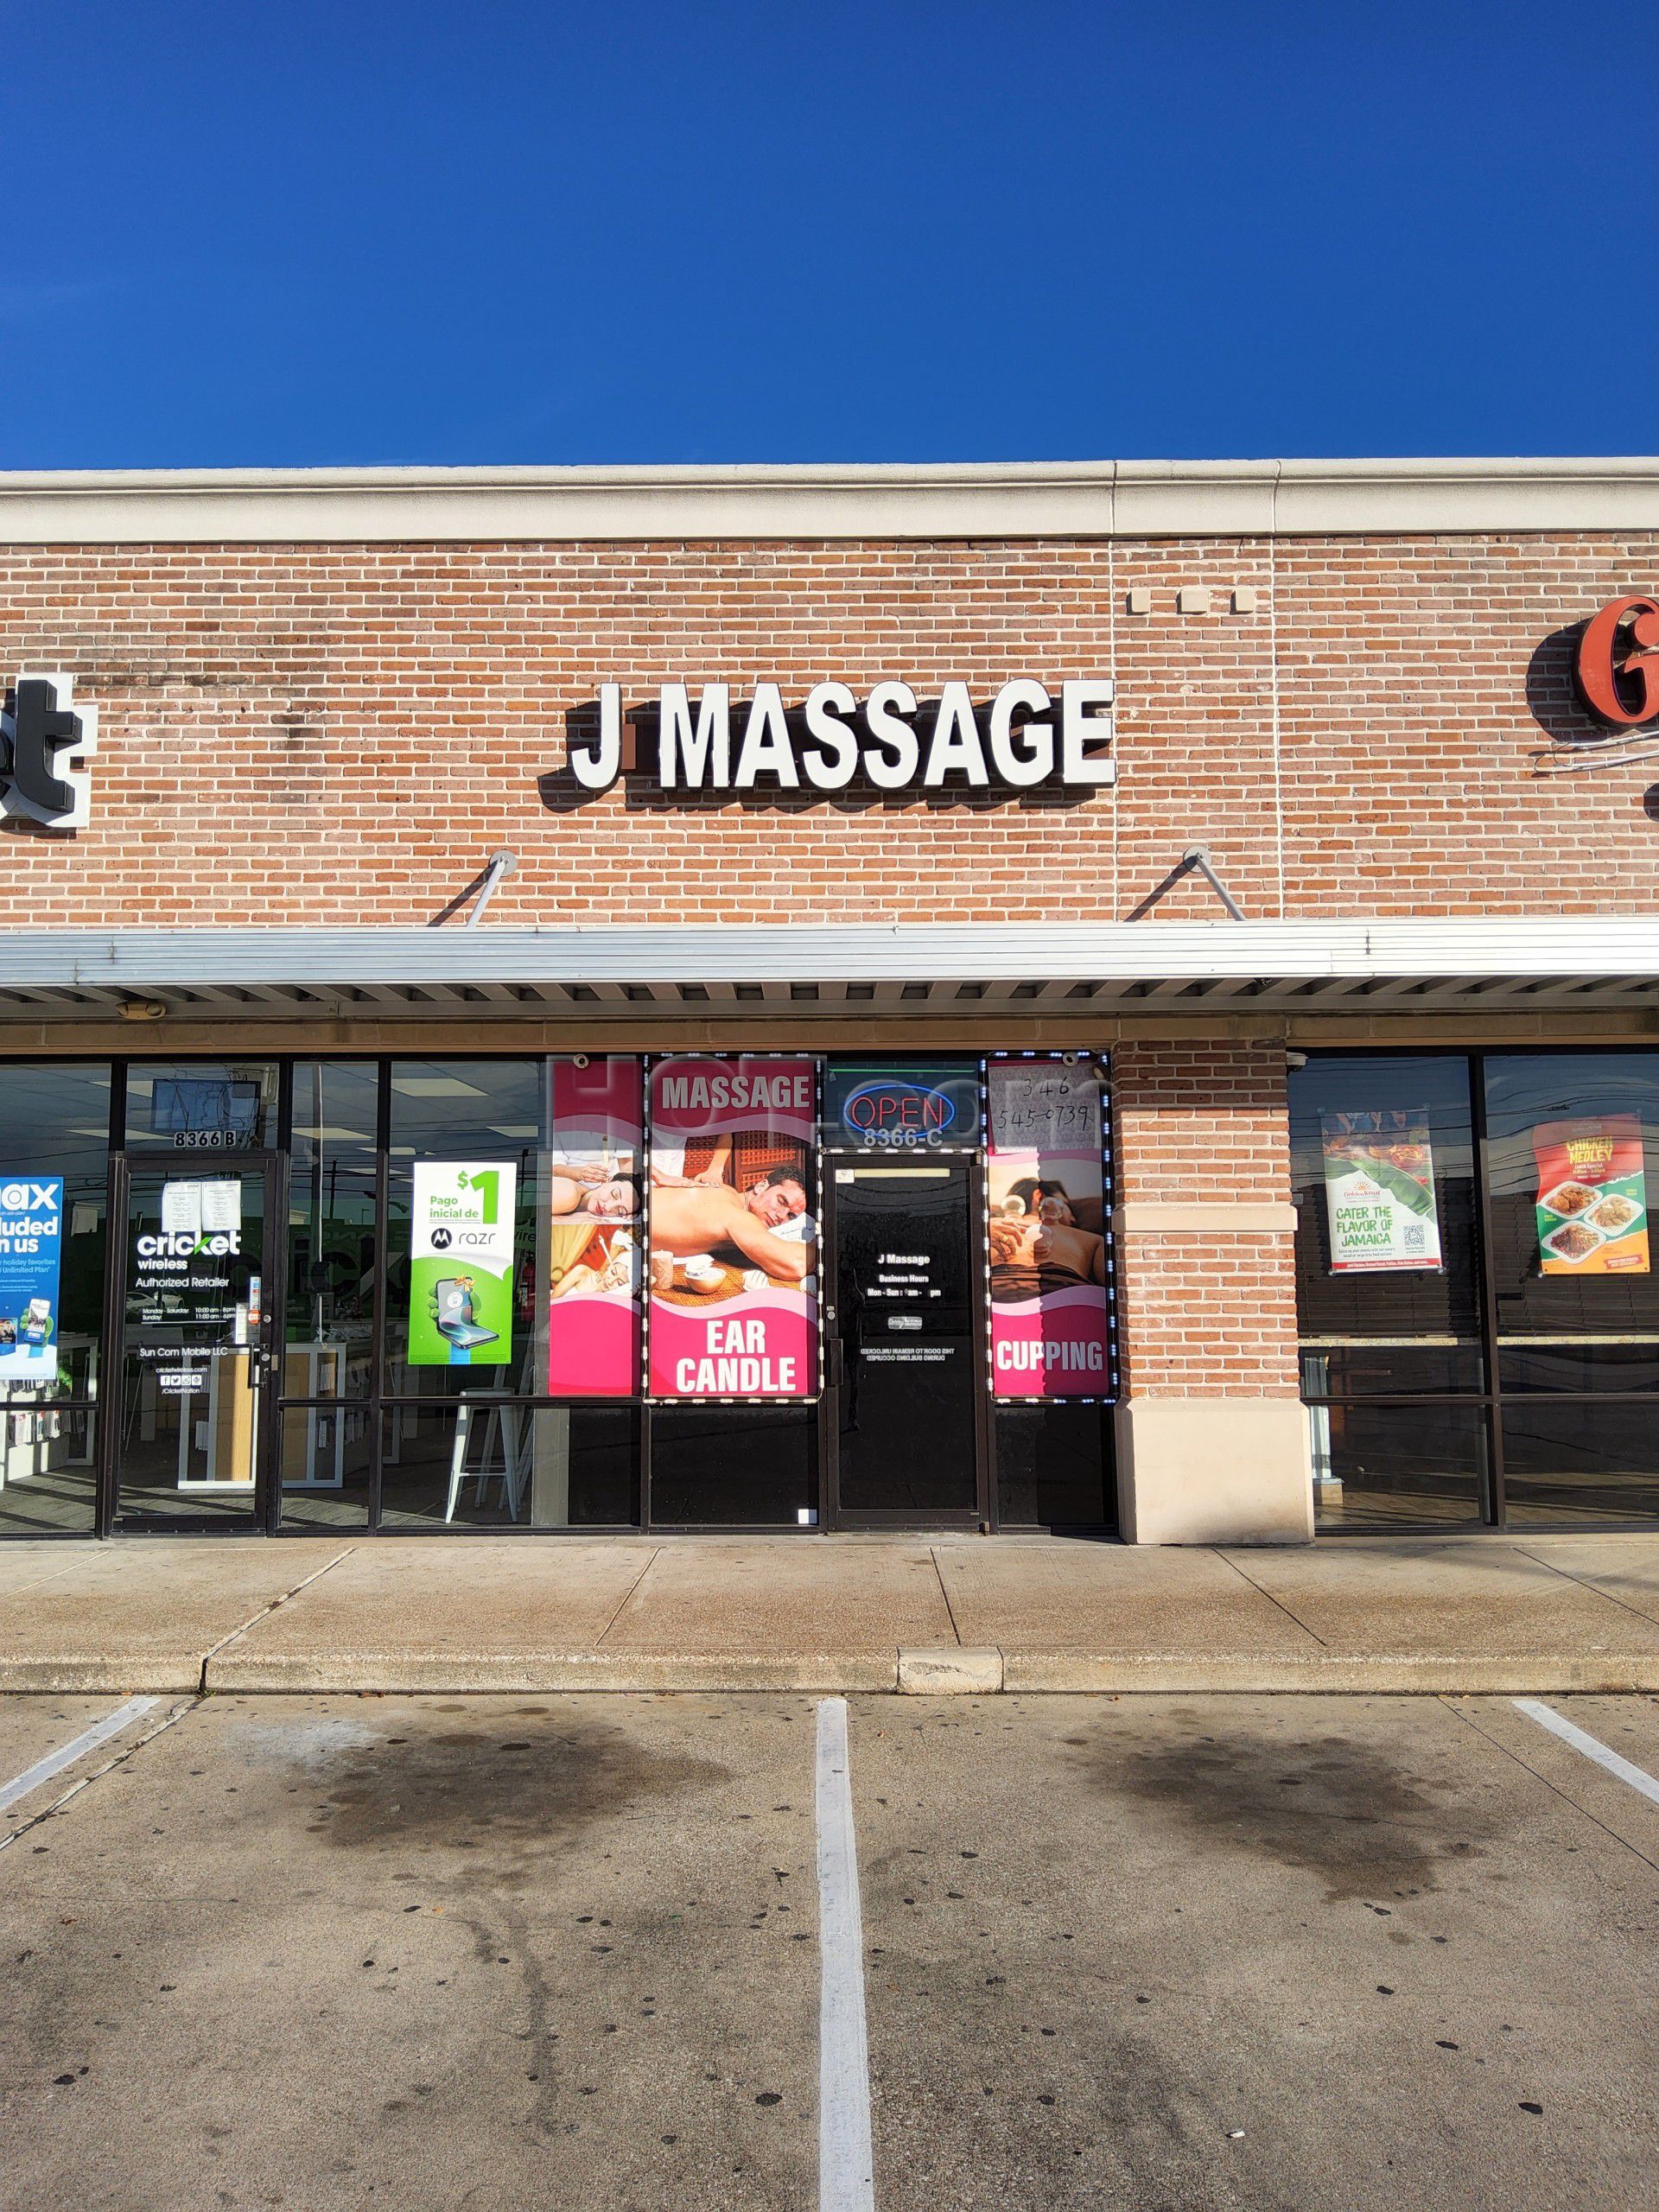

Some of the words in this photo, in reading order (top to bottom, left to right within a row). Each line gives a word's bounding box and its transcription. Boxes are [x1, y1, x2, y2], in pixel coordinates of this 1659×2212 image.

[571, 683, 620, 788] J
[659, 678, 1116, 789] MASSAGE
[662, 1076, 810, 1109] MASSAGE
[851, 1096, 944, 1129] OPEN
[175, 1132, 220, 1147] 8366
[226, 1132, 235, 1145] B
[864, 1128, 943, 1147] 8366-C
[1566, 1136, 1613, 1152] CHICKEN
[1569, 1148, 1613, 1164] MEDLEY
[0, 1184, 59, 1211] ax
[430, 1196, 458, 1208] Pago
[429, 1209, 461, 1217] inicial
[465, 1209, 479, 1217] de
[1336, 1207, 1369, 1219] CATER
[1372, 1206, 1392, 1218] THE
[1337, 1220, 1377, 1233] FLAVOR
[1381, 1219, 1393, 1230] OF
[137, 1230, 242, 1255] cricket
[459, 1233, 496, 1244] razr
[1342, 1233, 1391, 1247] JAMAICA
[15, 1239, 39, 1253] us
[138, 1258, 188, 1269] wireless
[878, 1255, 885, 1264] J
[887, 1255, 931, 1266] Massage
[136, 1278, 189, 1287] Authorized
[192, 1278, 229, 1287] Retailer
[879, 1274, 909, 1283] Business
[909, 1274, 930, 1283] Hours
[707, 1320, 766, 1354] EAR
[140, 1348, 156, 1357] Sun
[157, 1348, 180, 1357] Com
[181, 1347, 211, 1357] Mobile
[213, 1347, 228, 1356] LLC
[997, 1340, 1103, 1370] CUPPING
[677, 1357, 796, 1393] CANDLE
